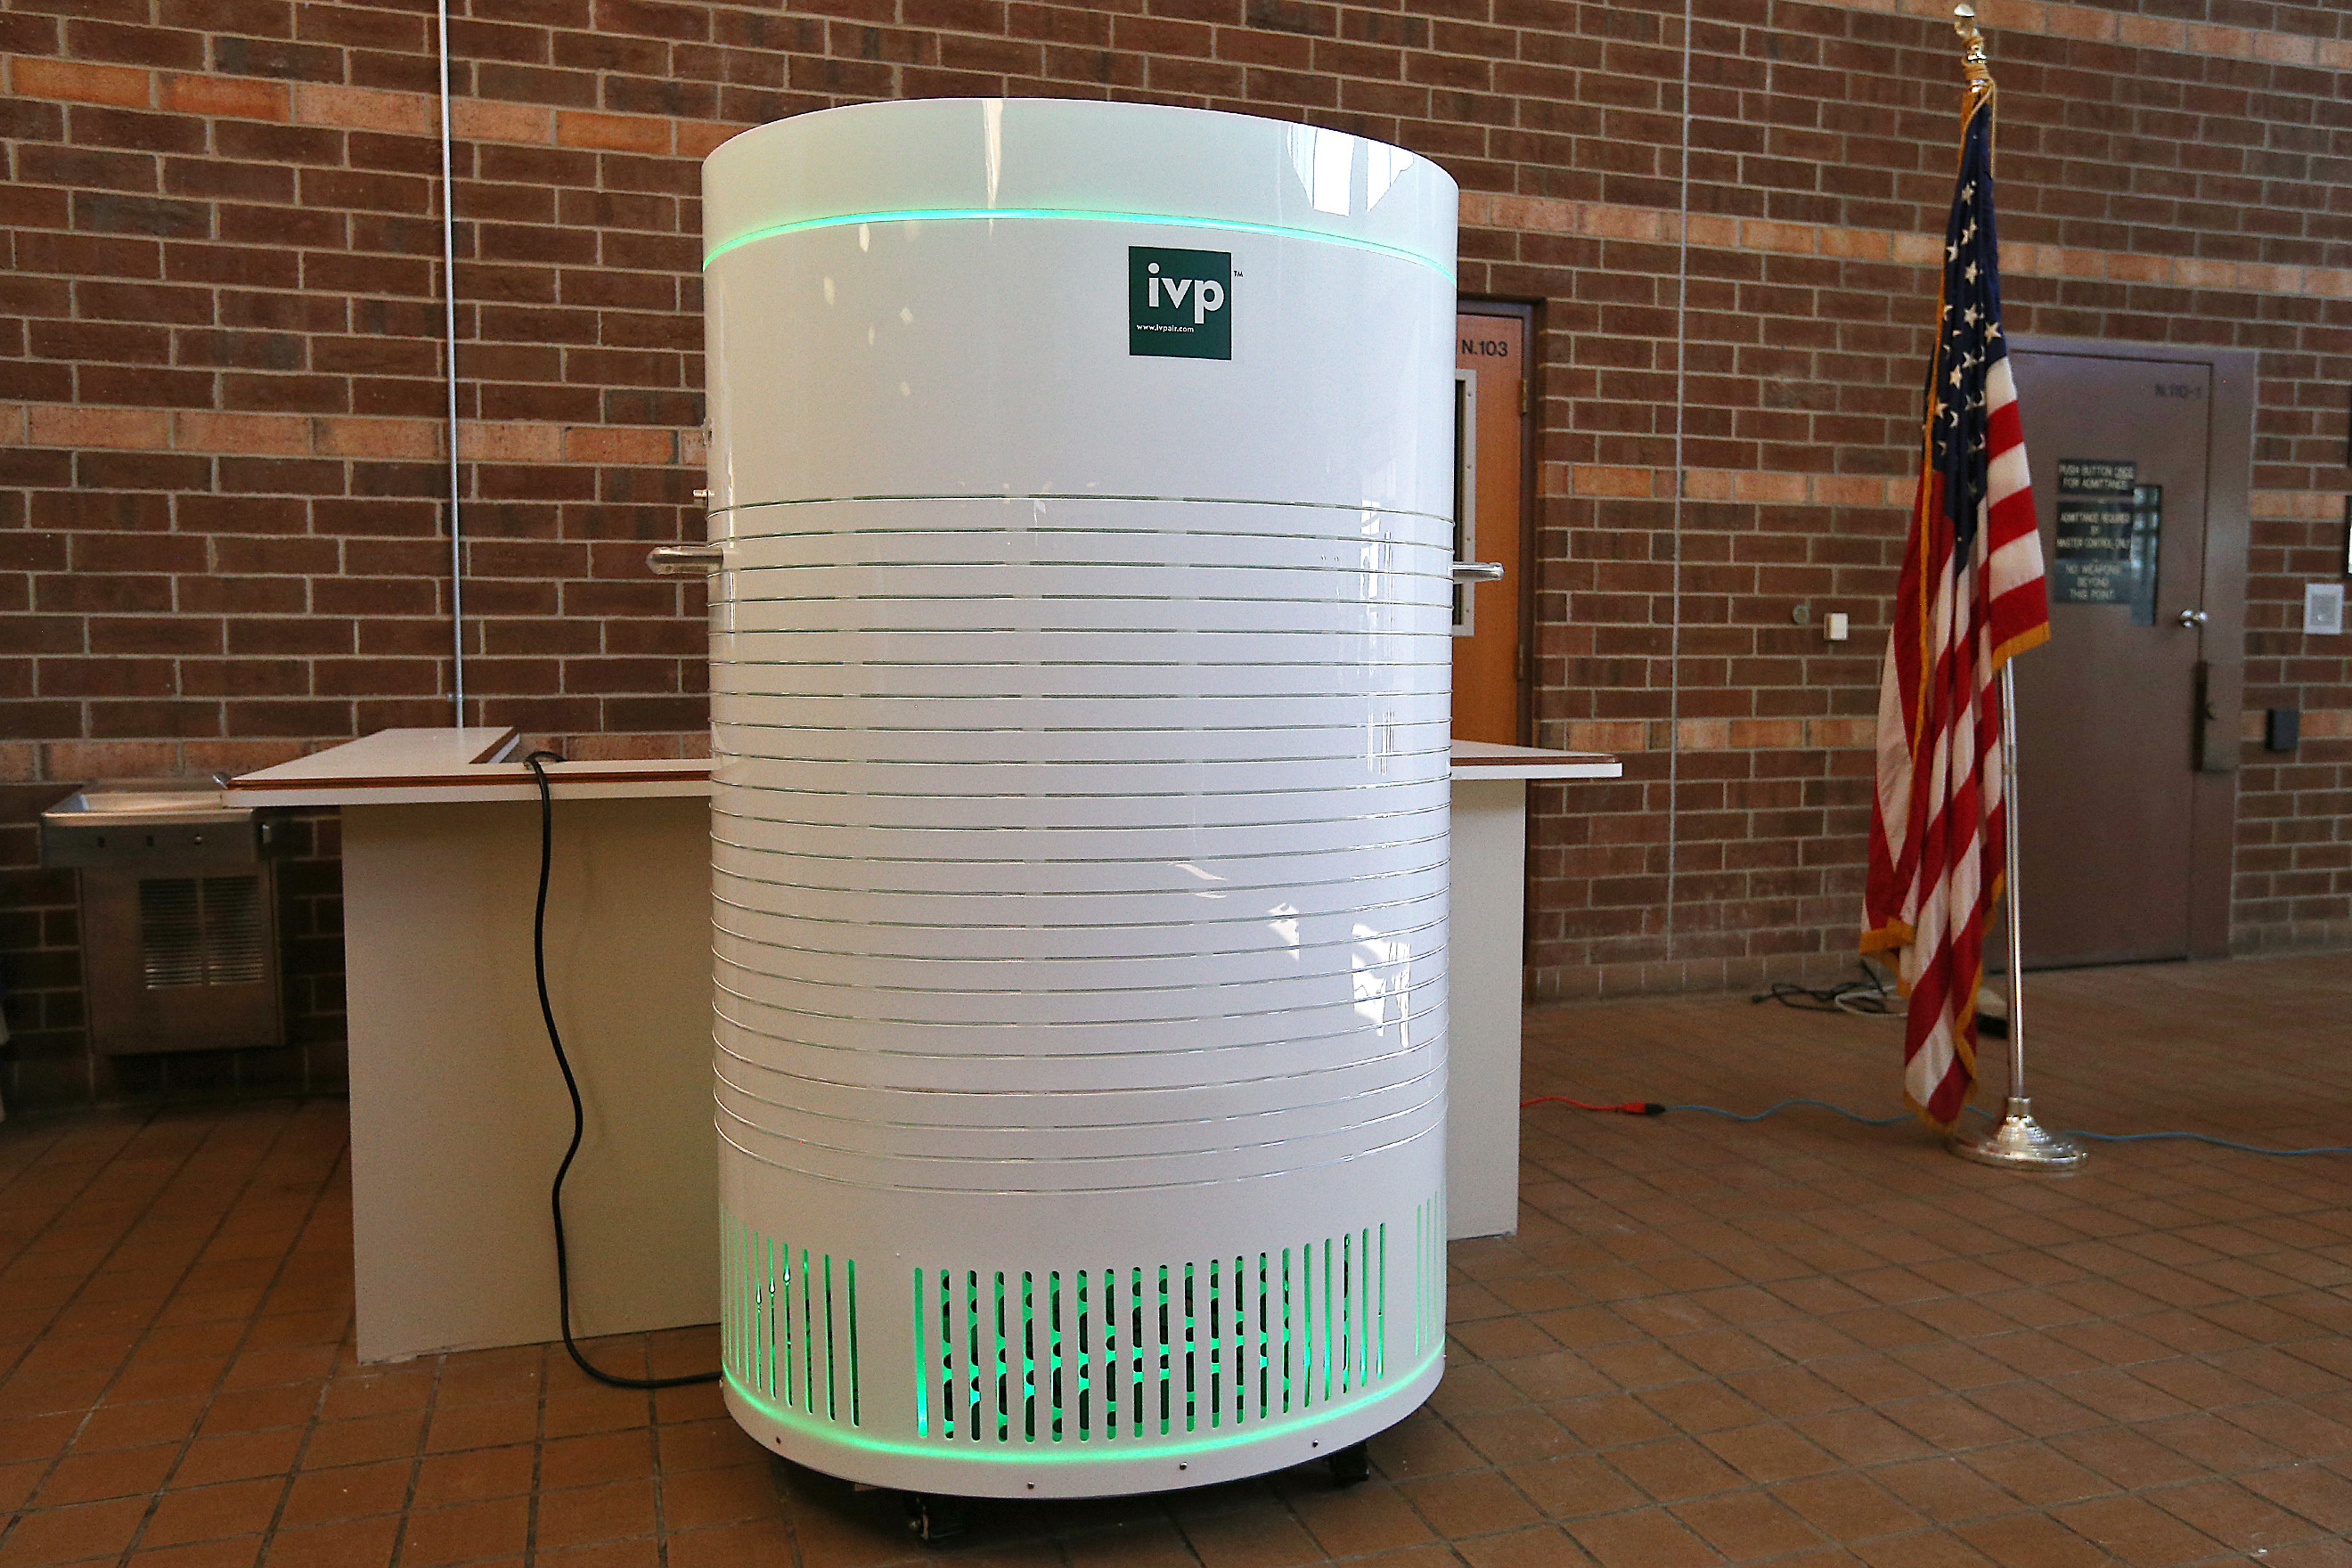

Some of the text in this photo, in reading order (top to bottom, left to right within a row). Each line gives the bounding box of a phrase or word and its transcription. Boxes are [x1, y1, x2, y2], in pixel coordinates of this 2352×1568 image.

[1147, 262, 1225, 324] ivp
[1136, 323, 1195, 333] www.ivpair.com
[1462, 339, 1507, 356] N.103
[2059, 464, 2079, 476] PUSH
[2081, 465, 2113, 477] BUTTON
[2062, 478, 2128, 489] FOR ADMITTANCE
[2060, 512, 2099, 523] ADMITTANCE
[2056, 538, 2083, 548] MASTER
[2085, 538, 2113, 549] CONTROL
[2065, 564, 2120, 576] NO WEAPONS
[2077, 576, 2110, 588] BEYOND
